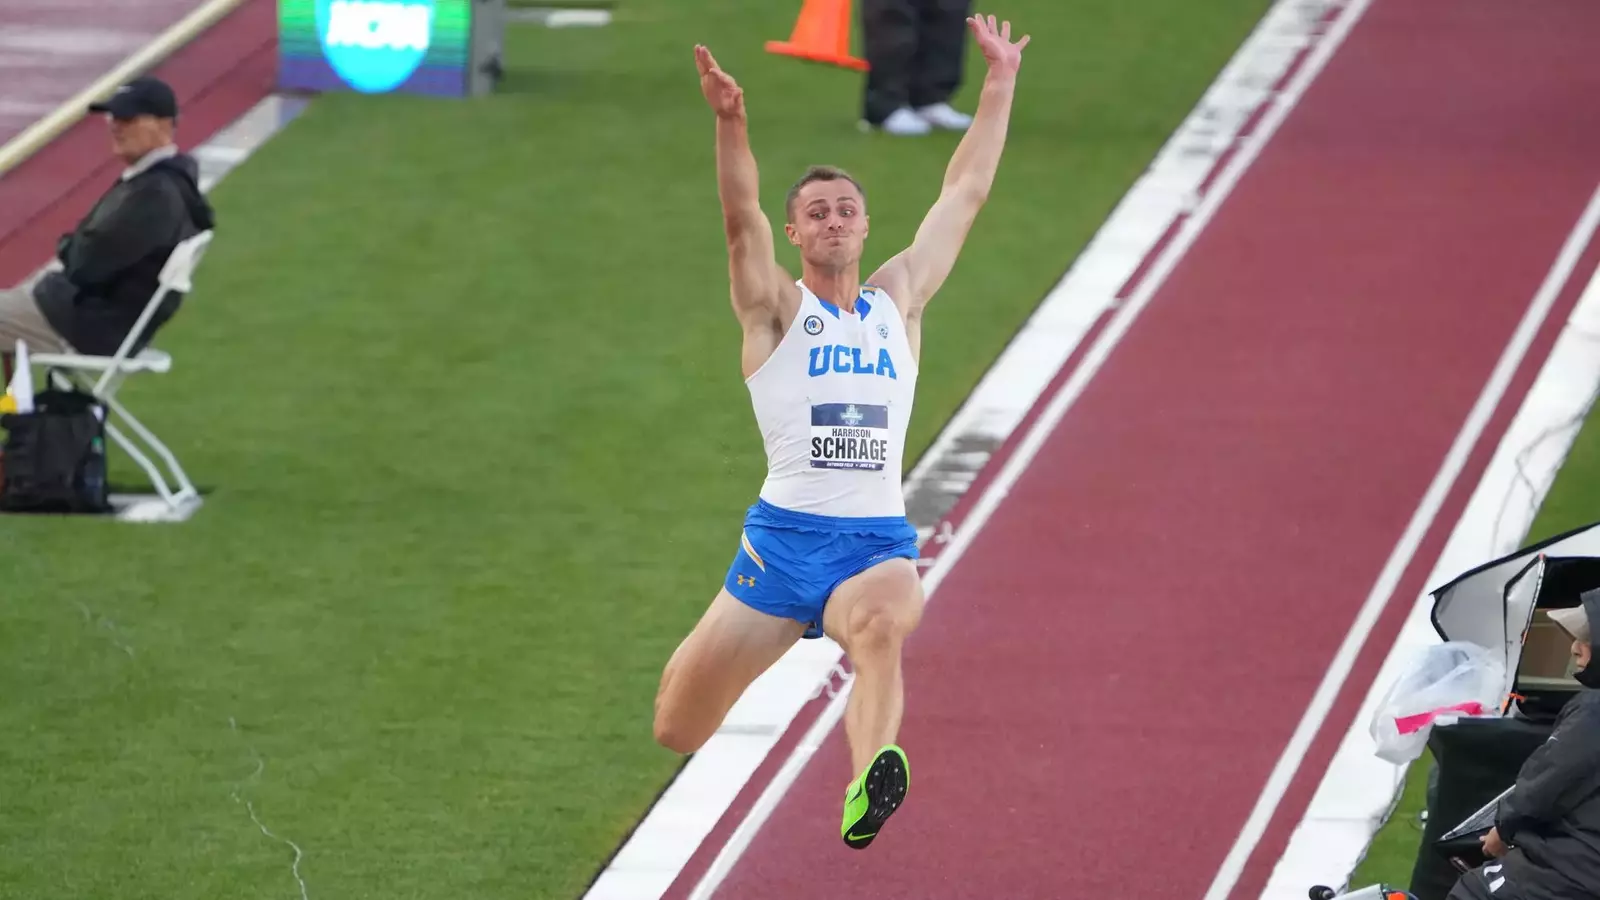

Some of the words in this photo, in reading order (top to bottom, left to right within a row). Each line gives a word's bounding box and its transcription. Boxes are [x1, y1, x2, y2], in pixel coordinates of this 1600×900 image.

[808, 345, 897, 380] UCLA
[832, 428, 871, 438] HARRISON
[811, 437, 888, 461] SCHRAGE
